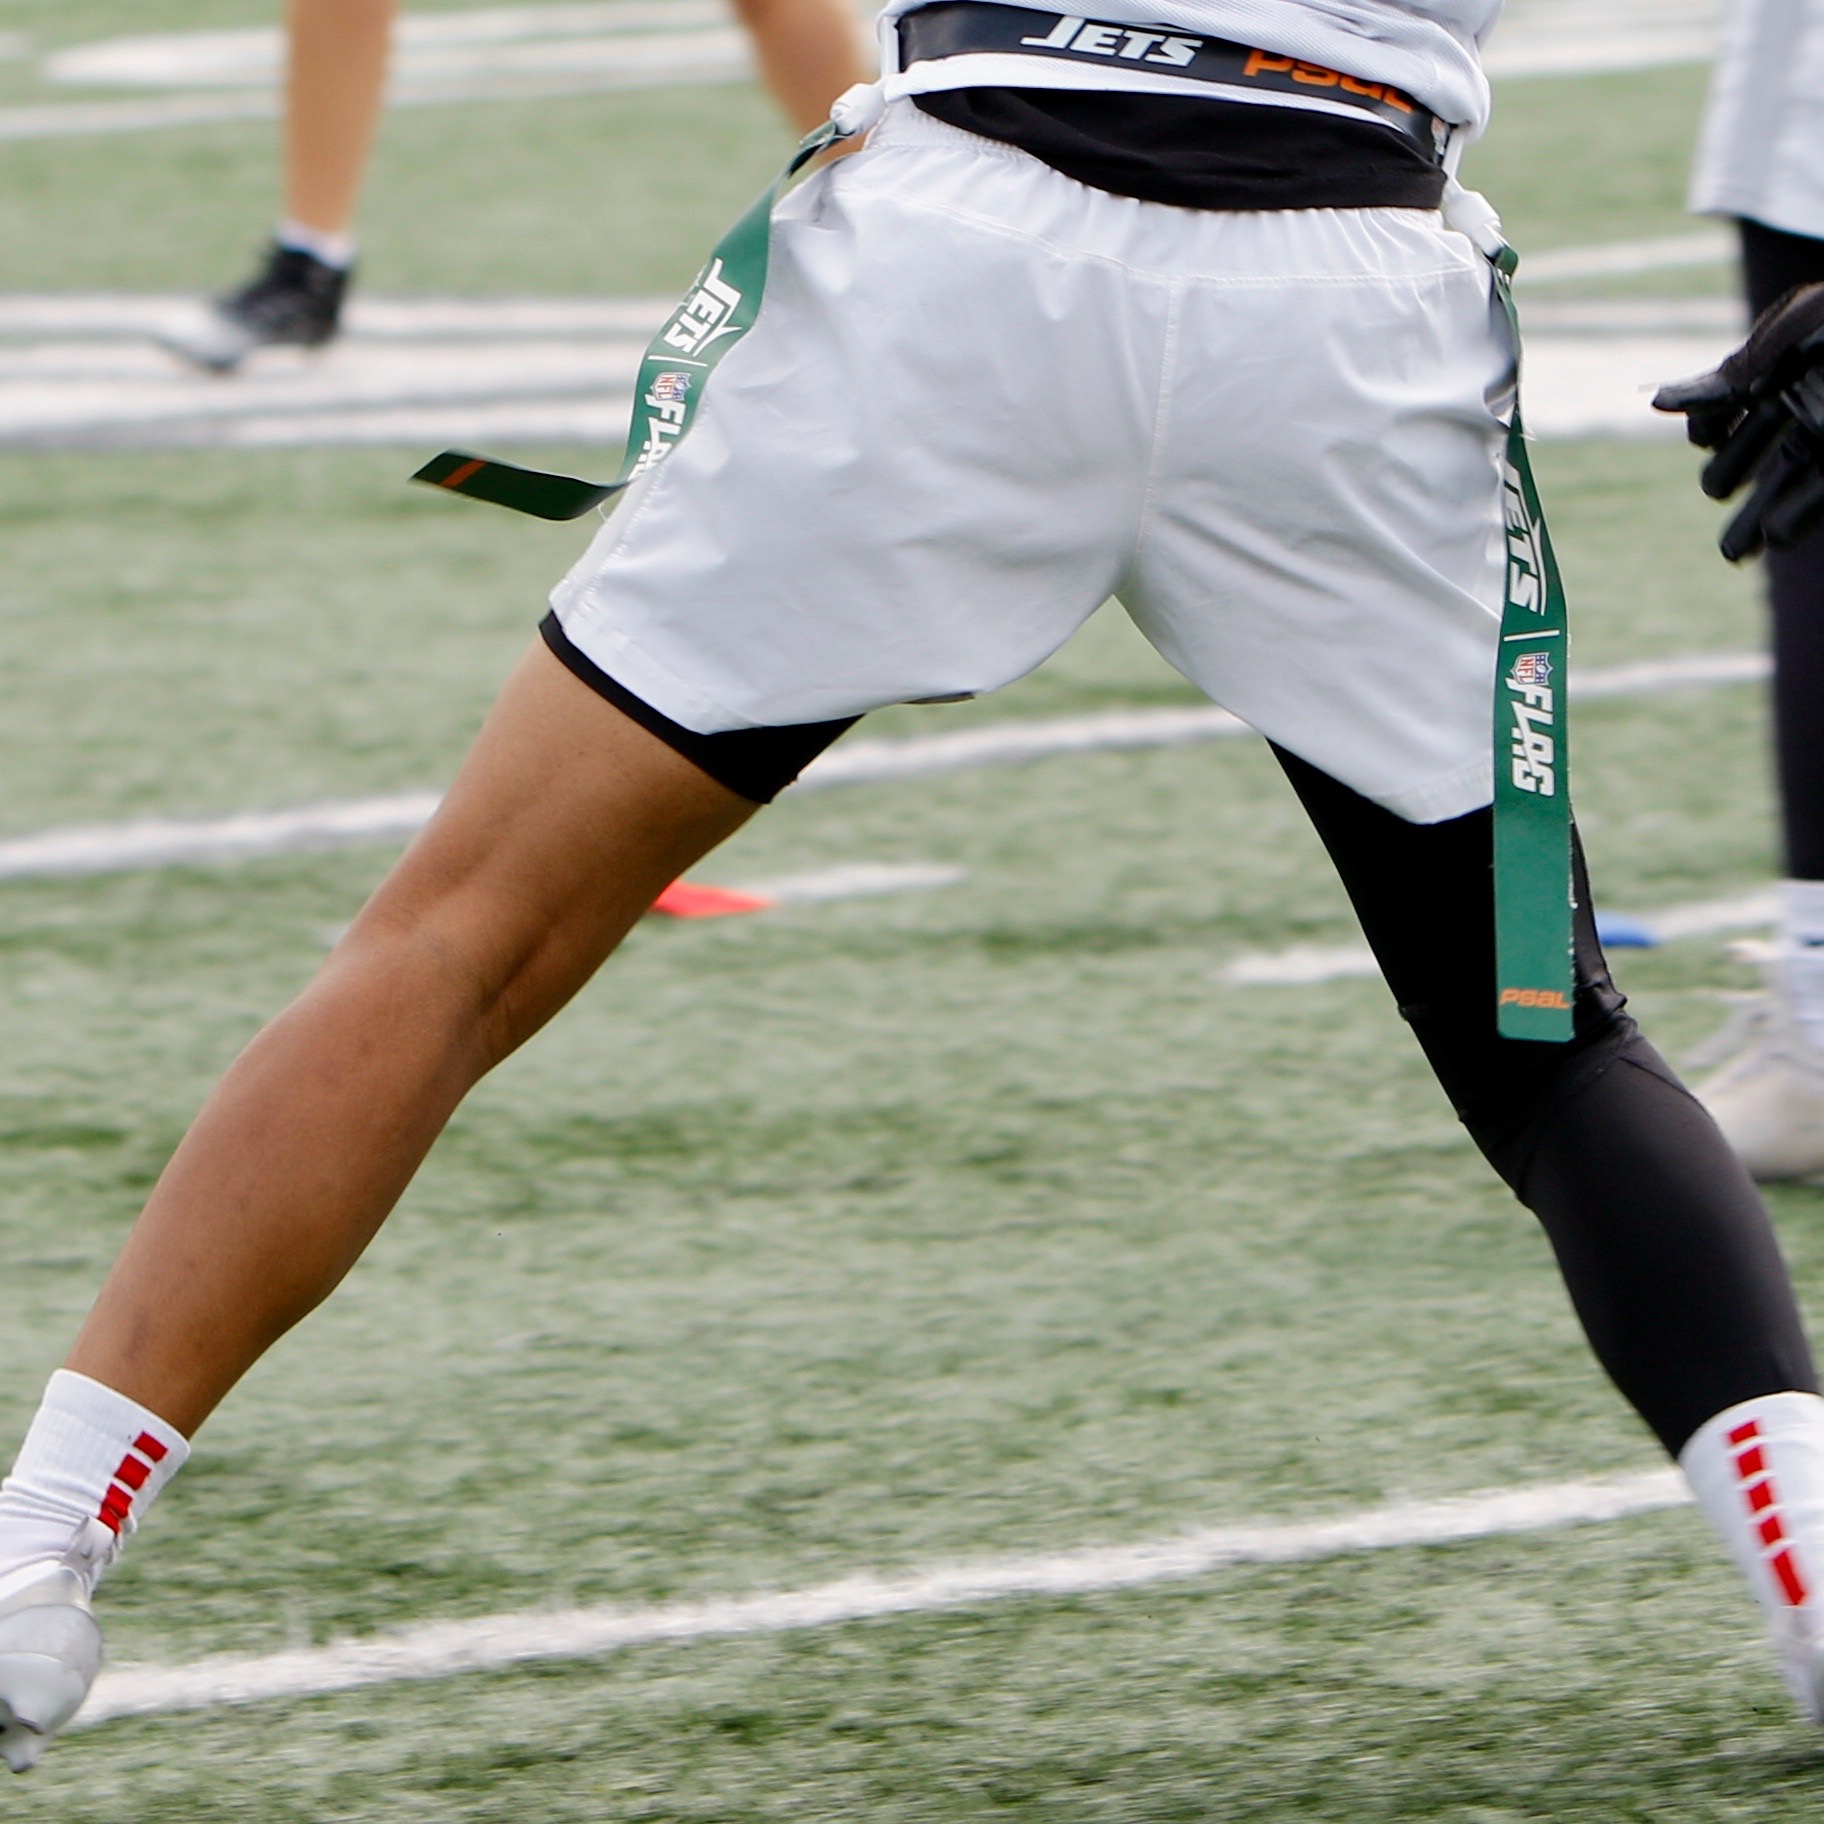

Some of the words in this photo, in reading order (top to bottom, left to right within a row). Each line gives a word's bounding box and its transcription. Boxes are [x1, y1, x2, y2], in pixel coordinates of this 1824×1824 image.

[1020, 14, 1204, 67] JETS
[662, 257, 743, 358] JETS
[628, 393, 687, 483] FLA
[1505, 676, 1556, 797] FLAG
